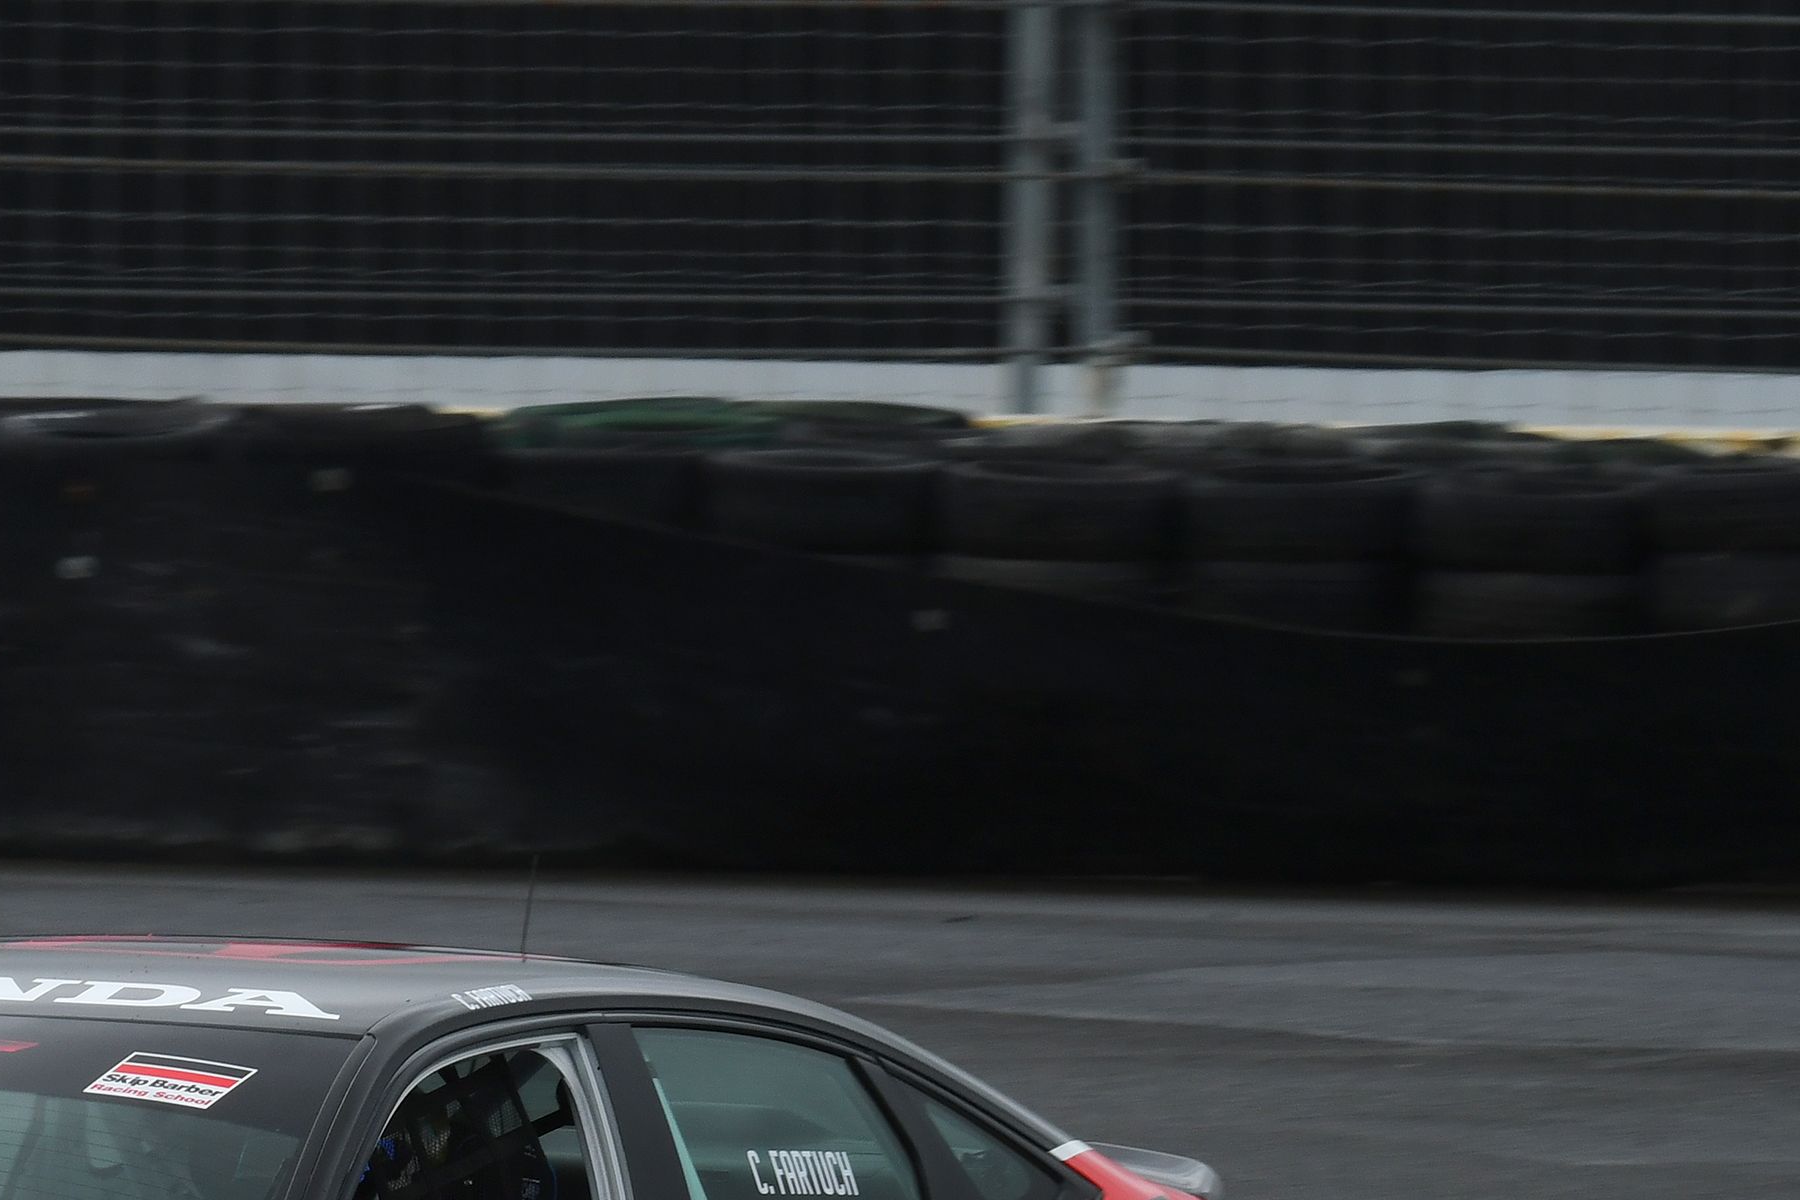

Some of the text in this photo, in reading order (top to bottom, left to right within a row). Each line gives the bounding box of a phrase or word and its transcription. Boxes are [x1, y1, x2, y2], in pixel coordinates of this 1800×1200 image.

[90, 1083, 212, 1106] Racing School
[102, 1073, 224, 1098] Skip Barber
[746, 1150, 860, 1196] C. FARTUCH
